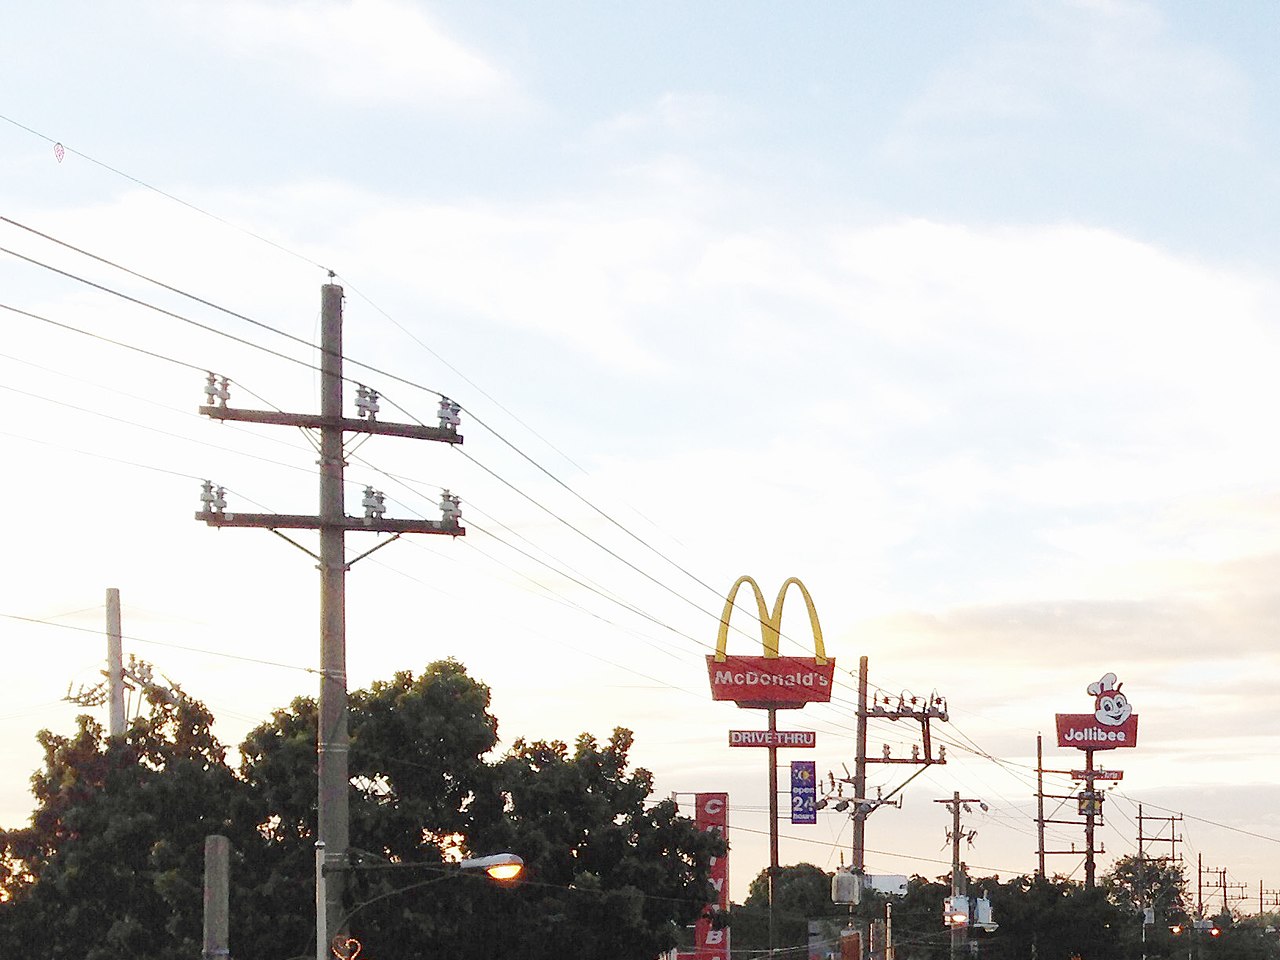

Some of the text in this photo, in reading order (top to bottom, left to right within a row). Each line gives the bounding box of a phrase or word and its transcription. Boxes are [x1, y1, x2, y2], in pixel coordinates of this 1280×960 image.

[715, 671, 829, 687] McDonald's
[1064, 726, 1127, 742] Jollibee
[793, 786, 815, 794] open
[793, 795, 814, 812] 24
[793, 813, 815, 821] hours
